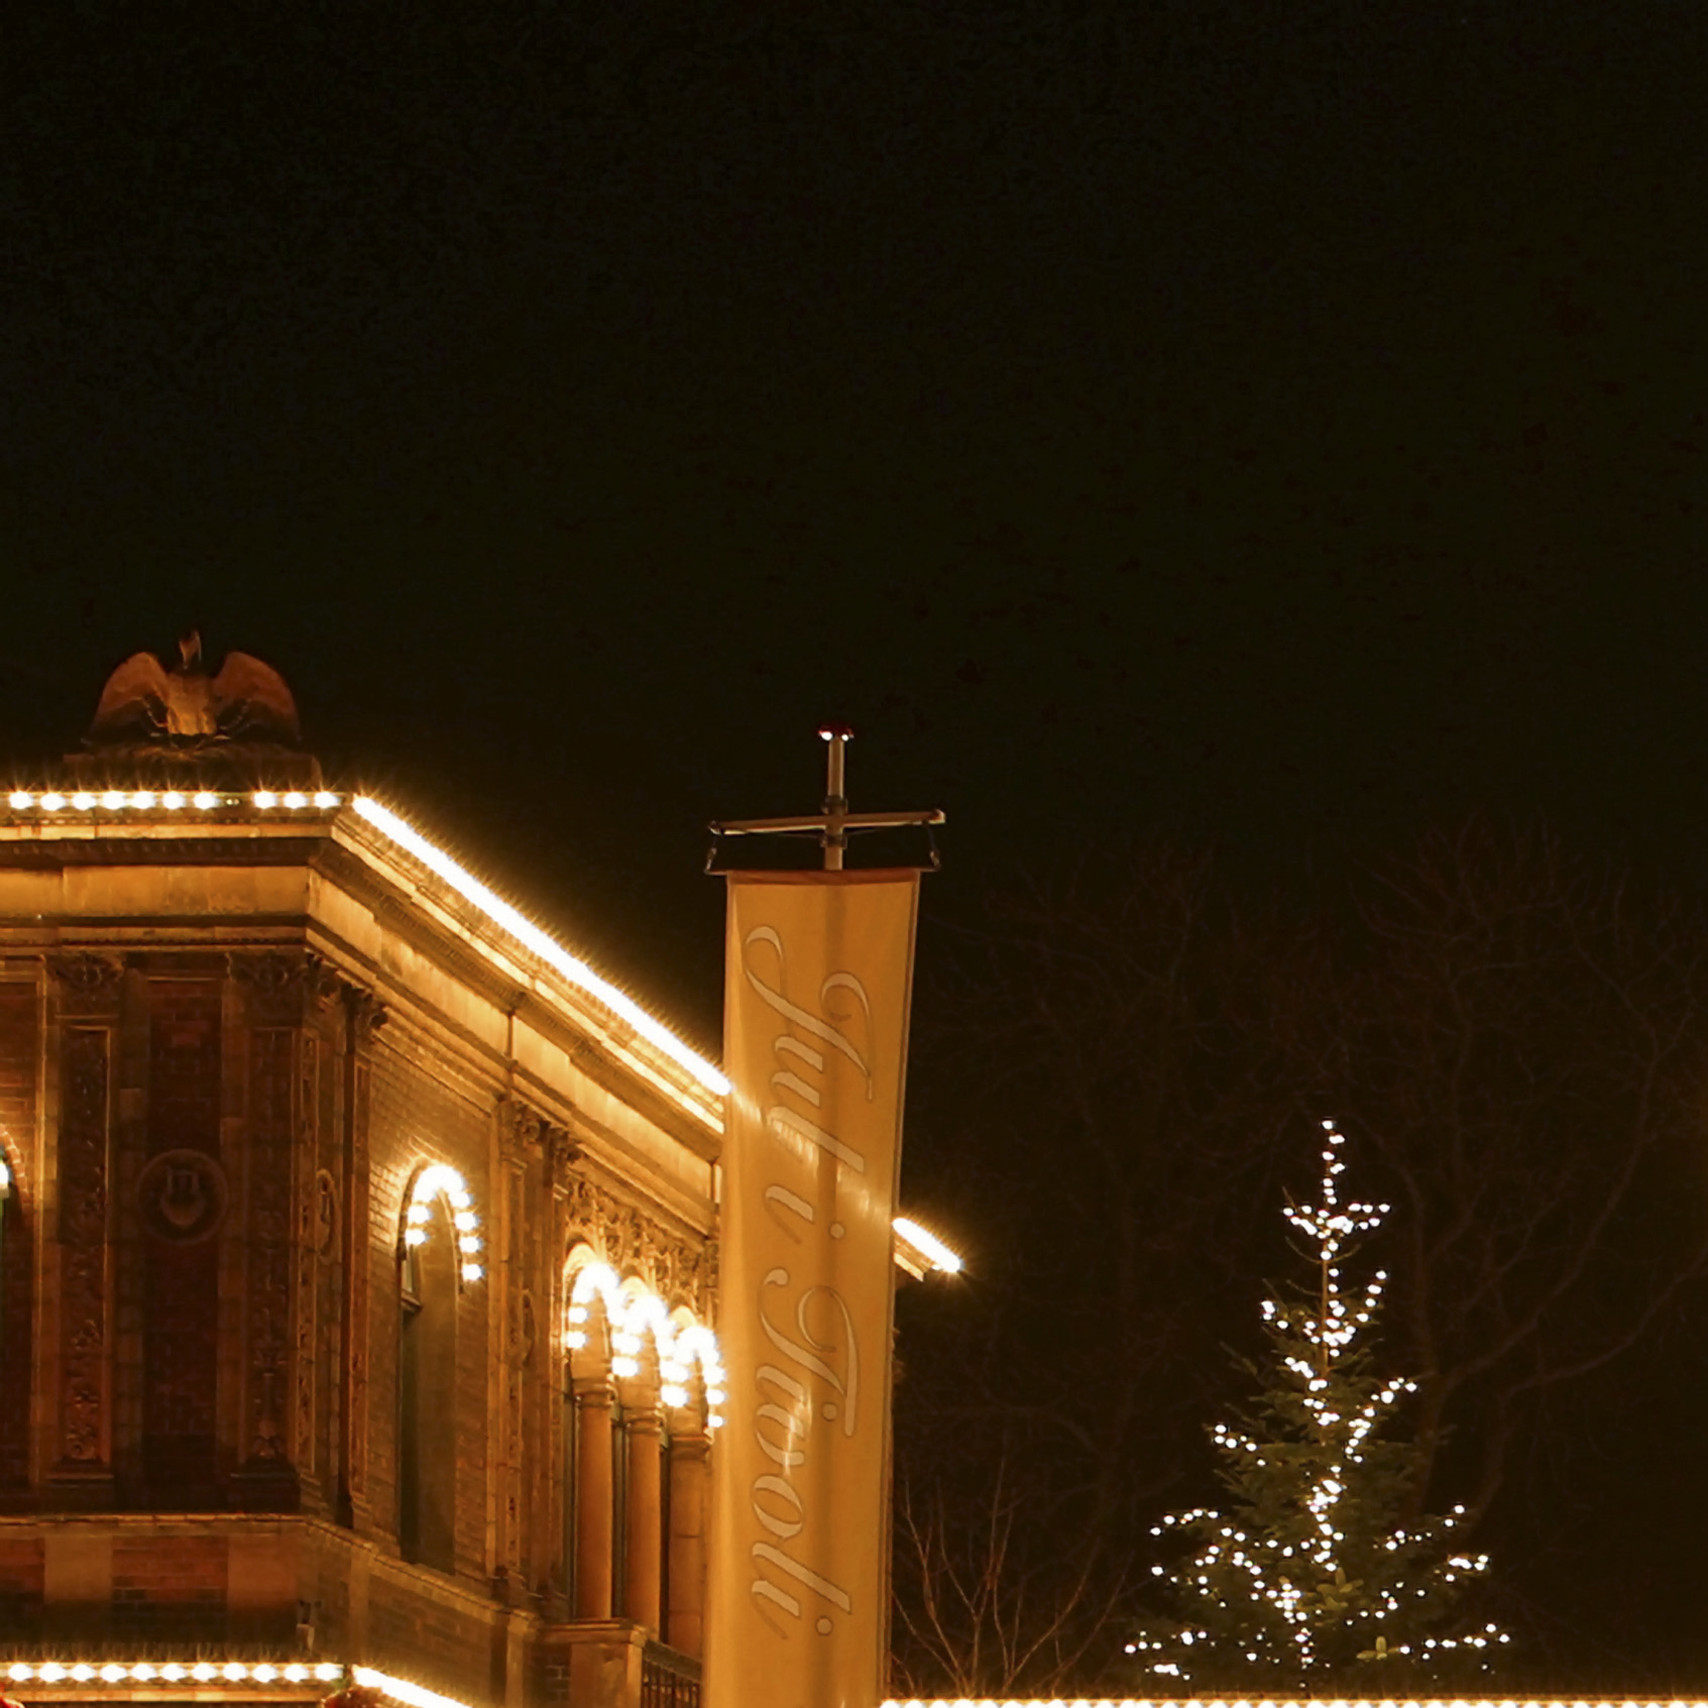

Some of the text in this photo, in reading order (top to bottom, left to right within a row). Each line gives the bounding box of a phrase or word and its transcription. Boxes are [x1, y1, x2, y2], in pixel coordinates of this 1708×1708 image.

[744, 925, 874, 1641] Jul i Tivoli
